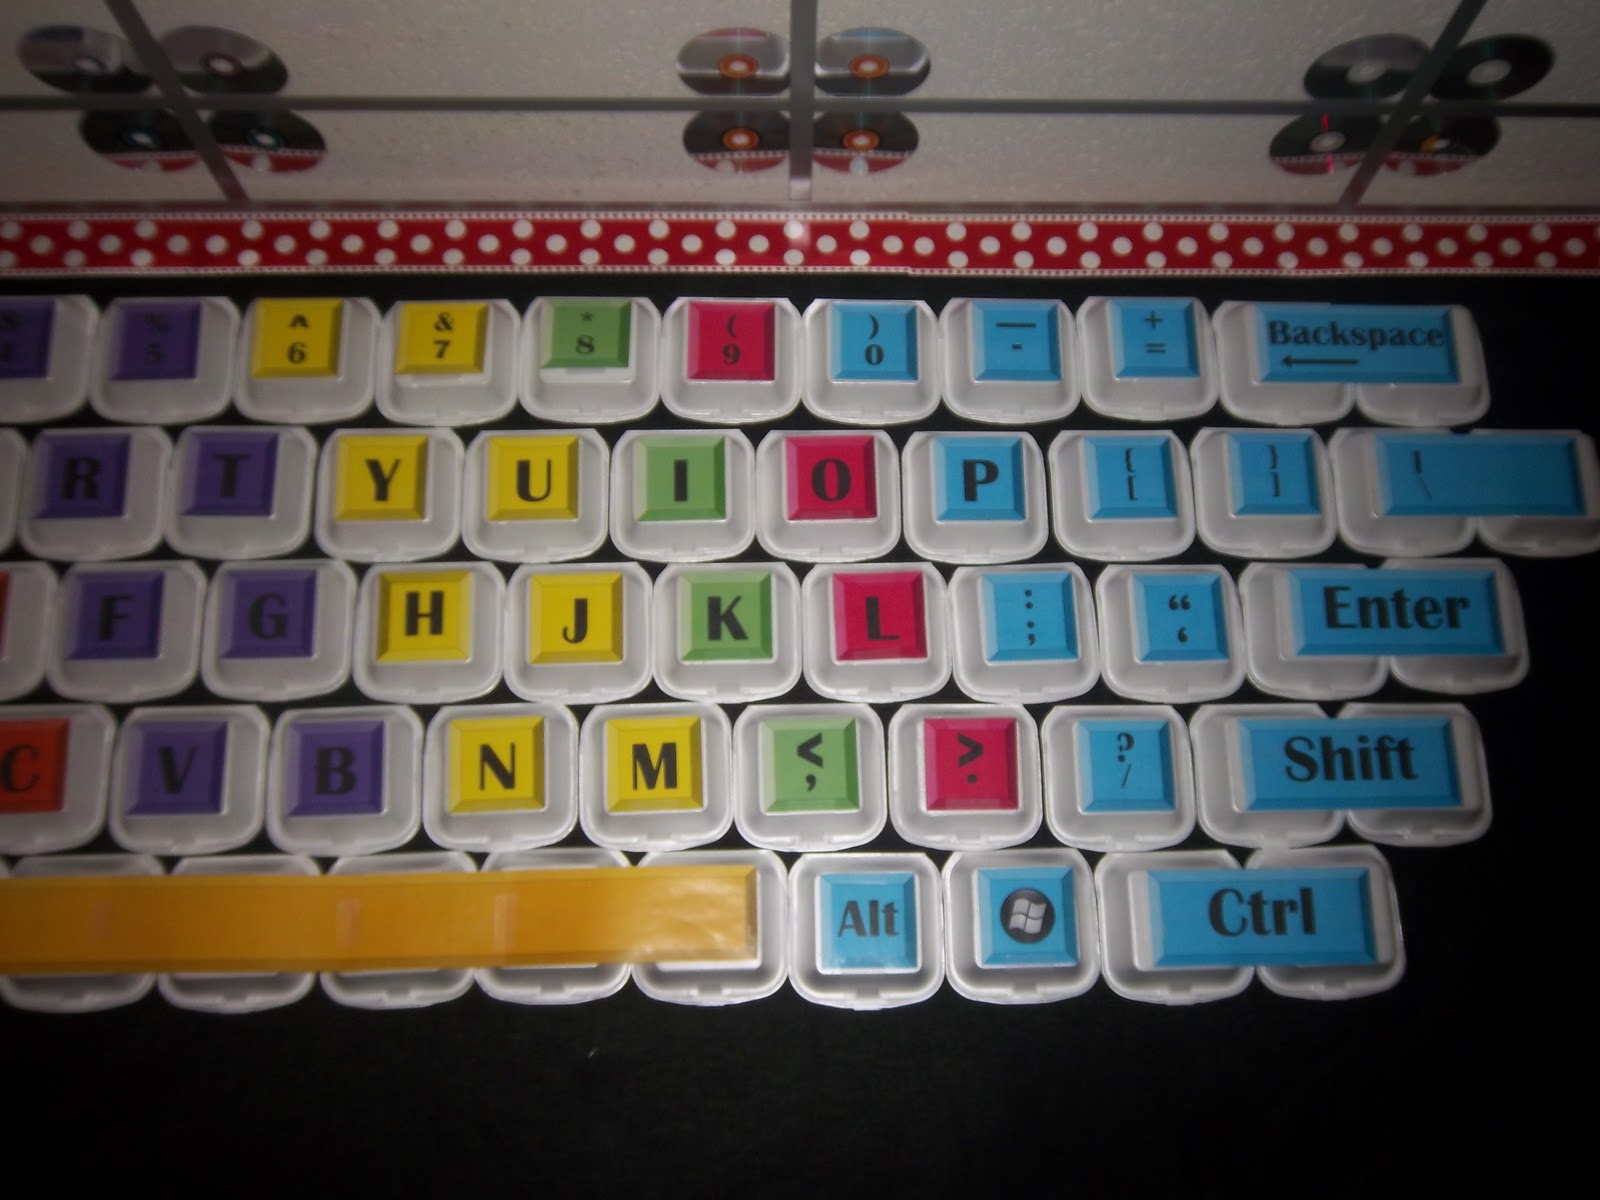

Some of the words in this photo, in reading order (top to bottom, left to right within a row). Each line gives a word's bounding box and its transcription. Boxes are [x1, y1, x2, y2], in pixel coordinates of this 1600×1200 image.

[433, 312, 454, 332] &
[1268, 320, 1446, 351] Backspace
[287, 342, 307, 363] 6
[433, 340, 450, 359] 7
[576, 335, 594, 354] 8
[723, 344, 740, 365] 9
[60, 457, 101, 499] R
[214, 455, 249, 497] T
[365, 459, 401, 502] Y
[517, 460, 551, 502] U
[674, 460, 689, 502] I
[811, 458, 852, 501] O
[963, 459, 999, 502] P
[98, 595, 134, 641] F
[248, 592, 287, 640] G
[405, 591, 444, 636] H
[562, 598, 588, 644] J
[707, 596, 748, 641] K
[865, 597, 899, 640] L
[1324, 585, 1470, 630] Enter
[1, 744, 39, 793] C
[480, 743, 515, 791] N
[632, 743, 677, 791] M
[1117, 732, 1134, 762] ?
[1285, 736, 1417, 782] Shift
[158, 746, 197, 793] V
[316, 747, 356, 795] B
[838, 900, 899, 937] Alt
[1209, 888, 1317, 936] Ctrl
